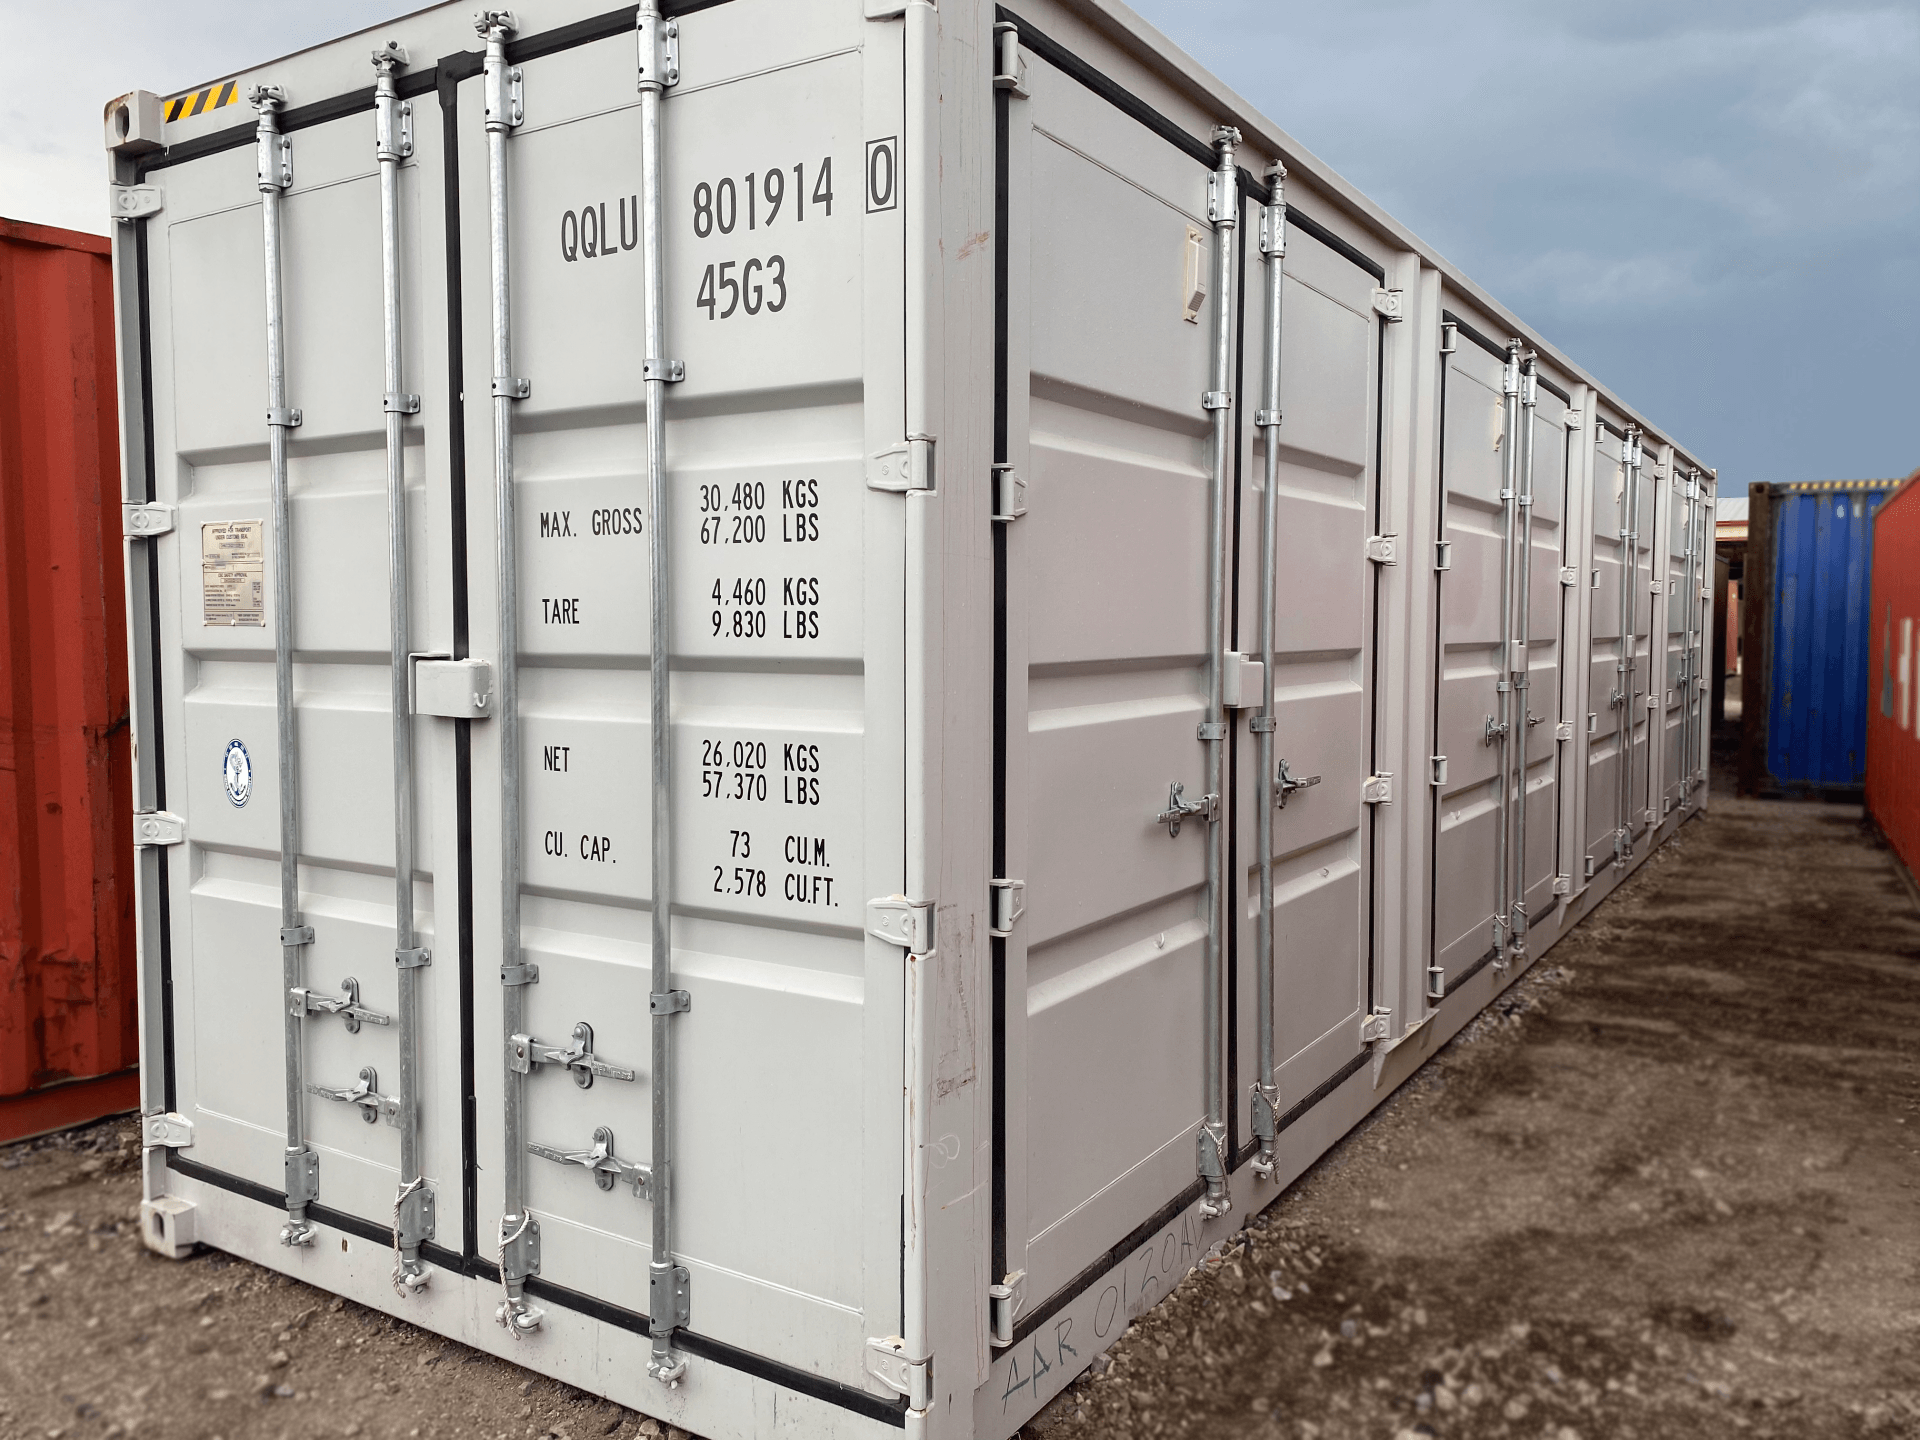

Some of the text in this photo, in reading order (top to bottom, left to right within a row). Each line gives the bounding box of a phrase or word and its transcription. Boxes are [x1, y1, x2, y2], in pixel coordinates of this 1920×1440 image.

[561, 144, 893, 263] QQLU 801914 0
[696, 254, 787, 321] 45G3
[699, 478, 819, 513] 30,480 KGS
[540, 507, 643, 538] MAX. GROSS
[700, 512, 819, 545] 67,200 LBS
[711, 577, 820, 606] 4,460 KGS
[541, 598, 580, 625] TARE
[711, 609, 819, 640] 9,830 LBS
[544, 739, 820, 773] NET 26,020 KGS
[702, 770, 820, 806] 57,370 LBS
[544, 829, 831, 868] CU. CAP. 73 CU.M.
[713, 865, 839, 907] 2,578 CU.FT.
